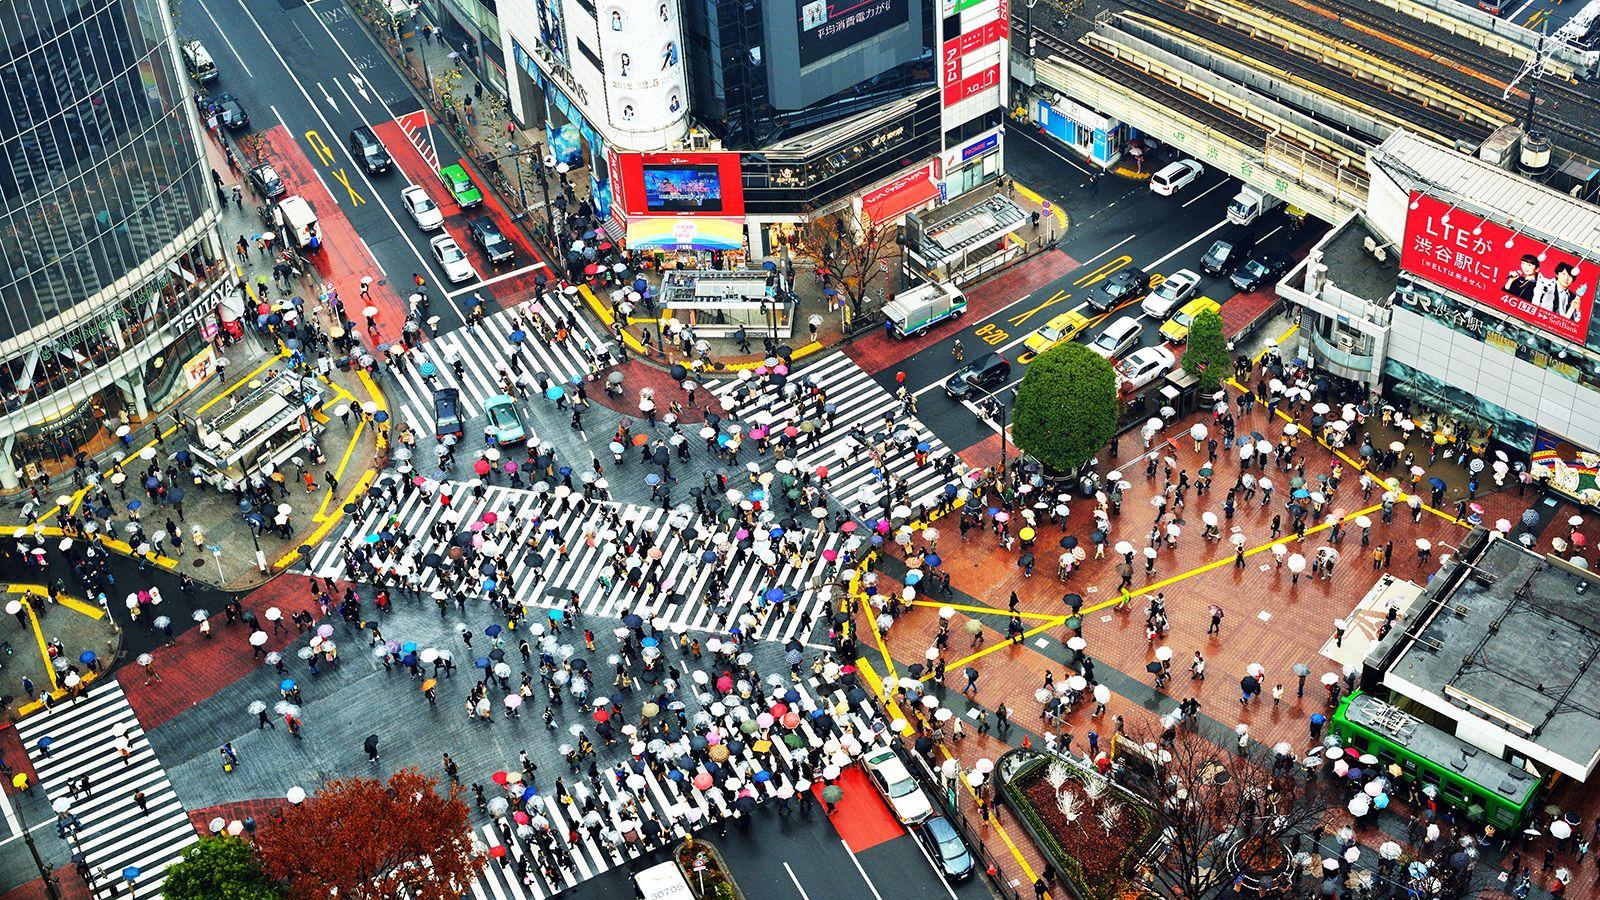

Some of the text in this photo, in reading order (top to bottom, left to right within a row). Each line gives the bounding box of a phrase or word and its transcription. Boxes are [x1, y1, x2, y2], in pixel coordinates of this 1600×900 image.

[947, 48, 958, 83] アコム
[966, 83, 979, 95] 入口
[1426, 216, 1492, 255] LTEが
[1413, 235, 1499, 283] 渋谷駅に!
[175, 279, 233, 335] TSUTAYA
[1401, 293, 1485, 334] JR 渋谷駅
[1500, 294, 1537, 316] 4G LTE
[974, 323, 1009, 346] 8-20
[1548, 316, 1578, 334] SoftBank
